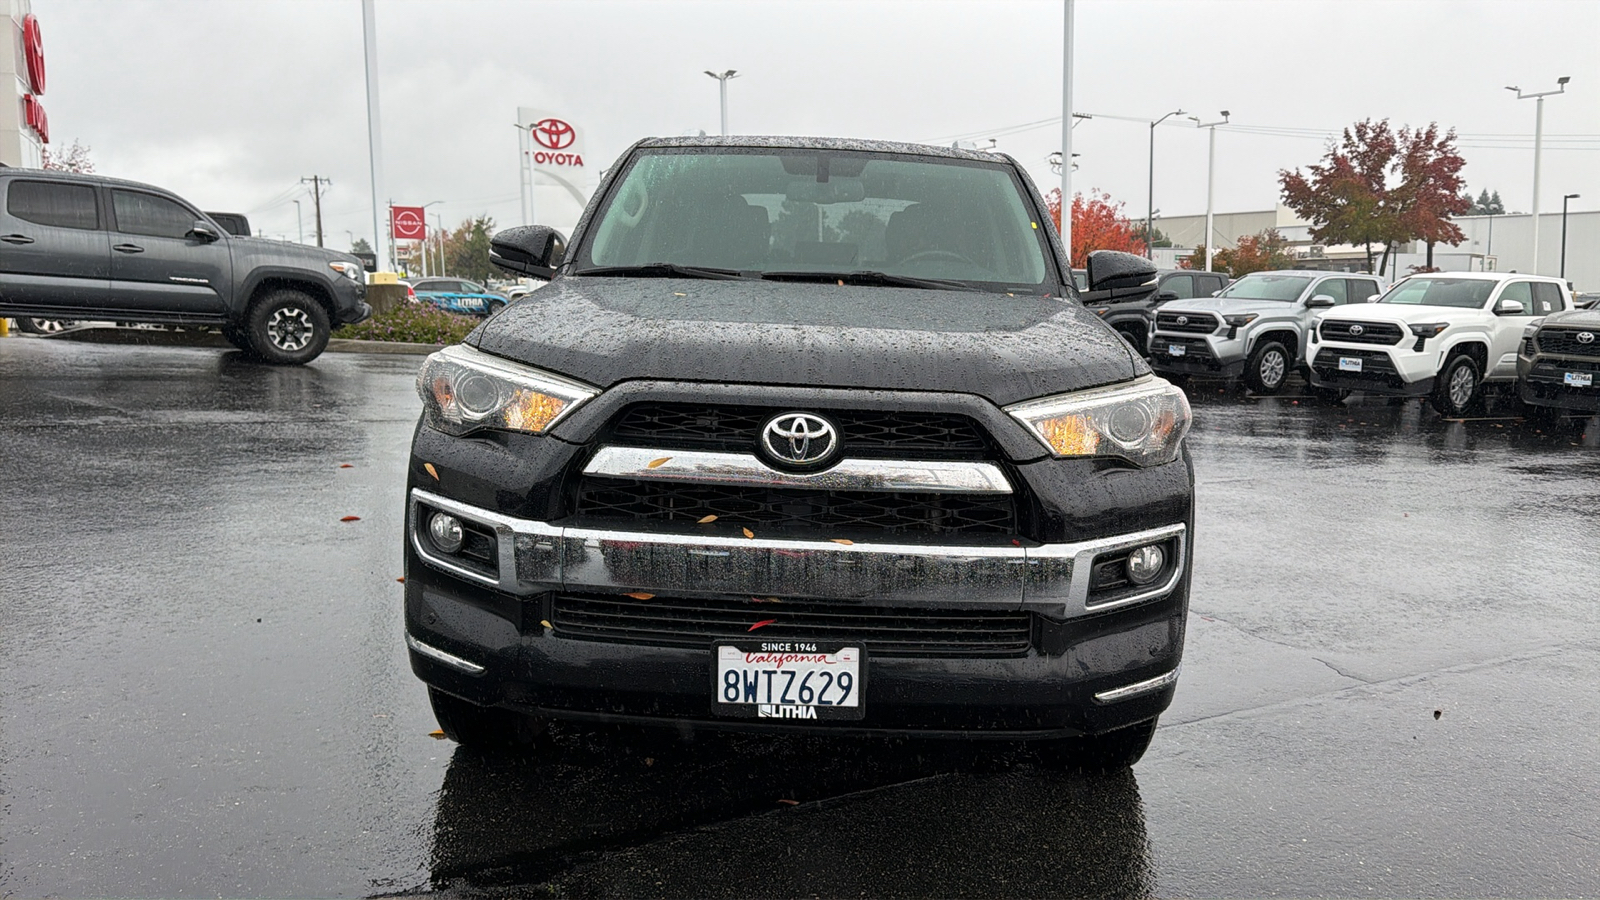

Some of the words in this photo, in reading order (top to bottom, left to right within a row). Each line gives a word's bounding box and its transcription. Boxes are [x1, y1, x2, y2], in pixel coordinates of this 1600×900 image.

[525, 151, 584, 166] OYOTA
[457, 298, 483, 307] LITHIA
[761, 643, 791, 652] SINCE
[794, 643, 817, 652] 1946
[745, 652, 837, 668] California
[724, 669, 853, 705] 8WTZ629
[772, 705, 817, 719] LITHIA
